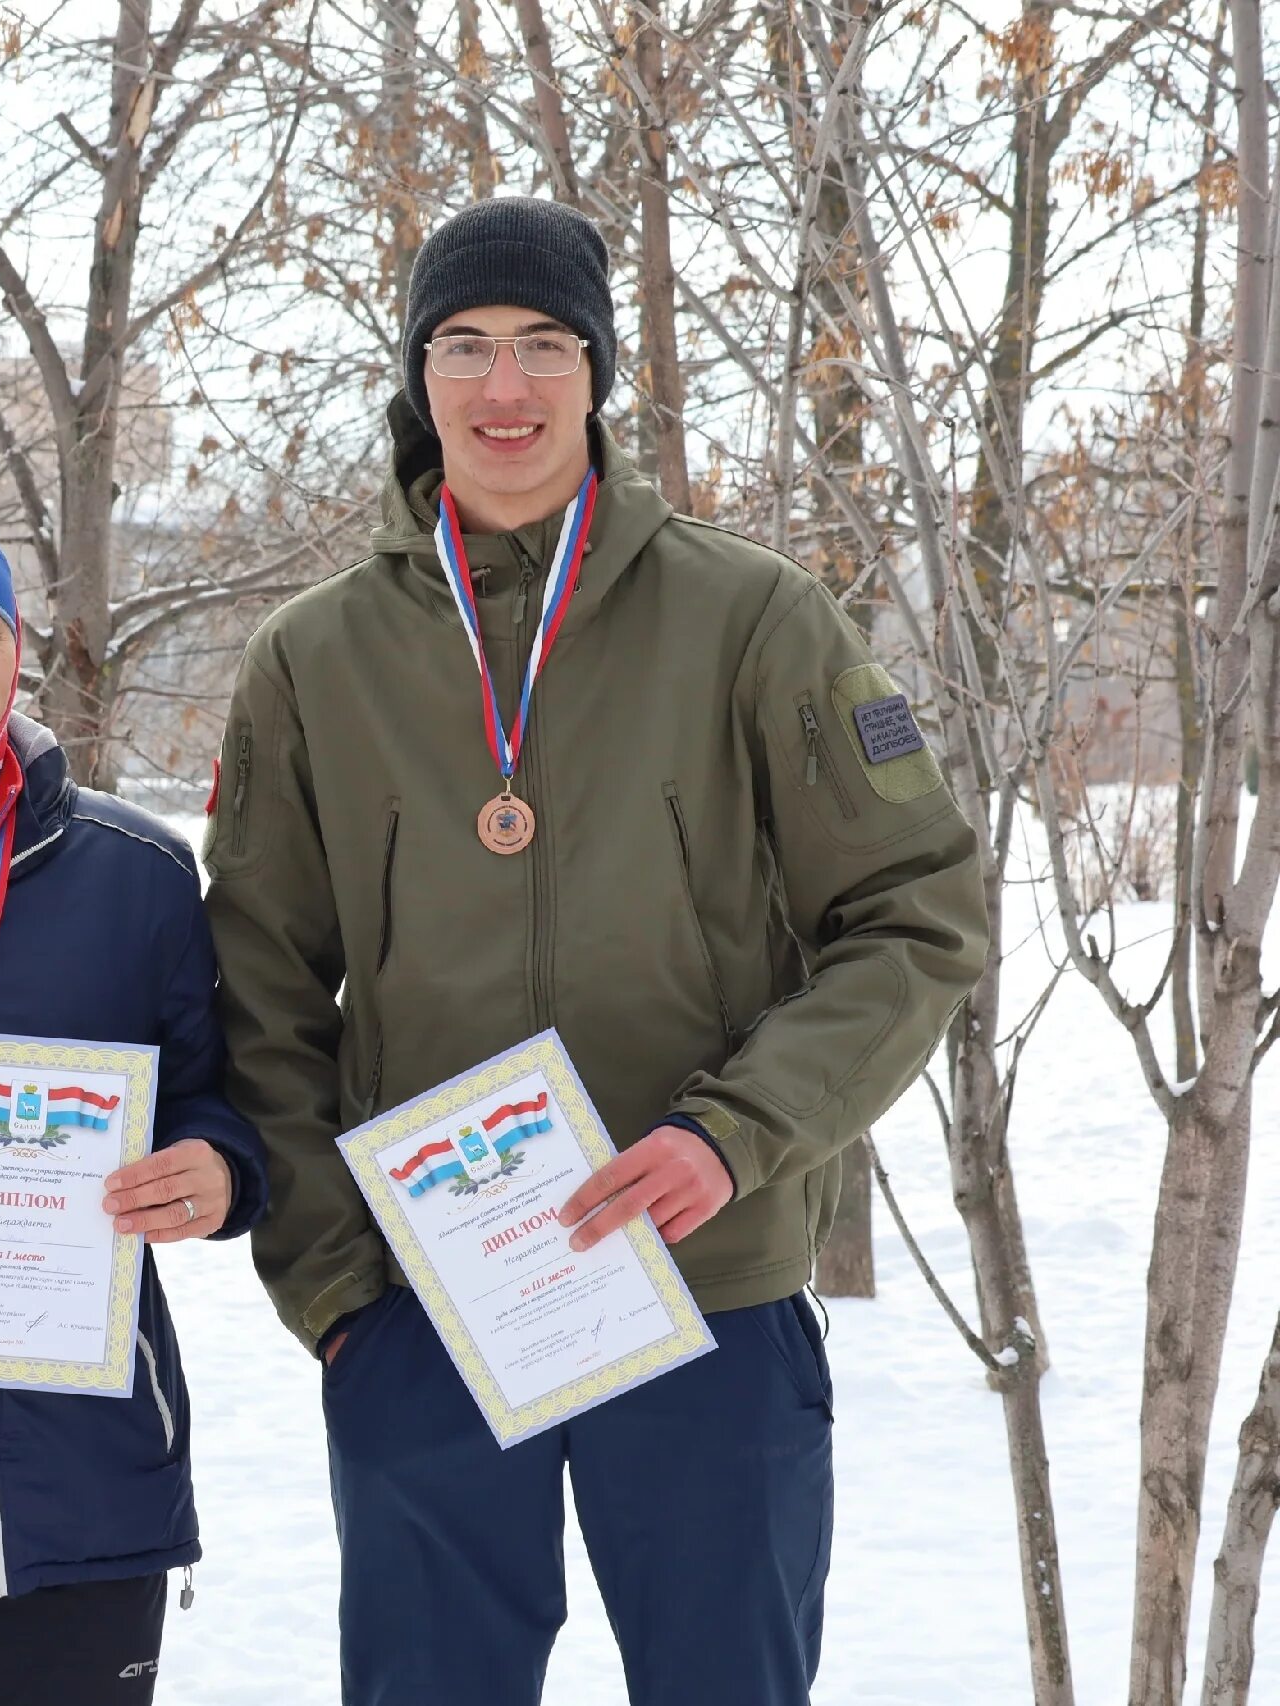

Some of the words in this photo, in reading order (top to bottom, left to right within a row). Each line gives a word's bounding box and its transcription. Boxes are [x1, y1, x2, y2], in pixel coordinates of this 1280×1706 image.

[481, 1207, 560, 1257] ДИПЛОМ
[6, 1250, 10, 1259] I
[13, 1252, 45, 1262] место
[504, 1234, 559, 1266] Награждается
[519, 1287, 530, 1297] за
[529, 1277, 547, 1291] III
[546, 1263, 577, 1283] место
